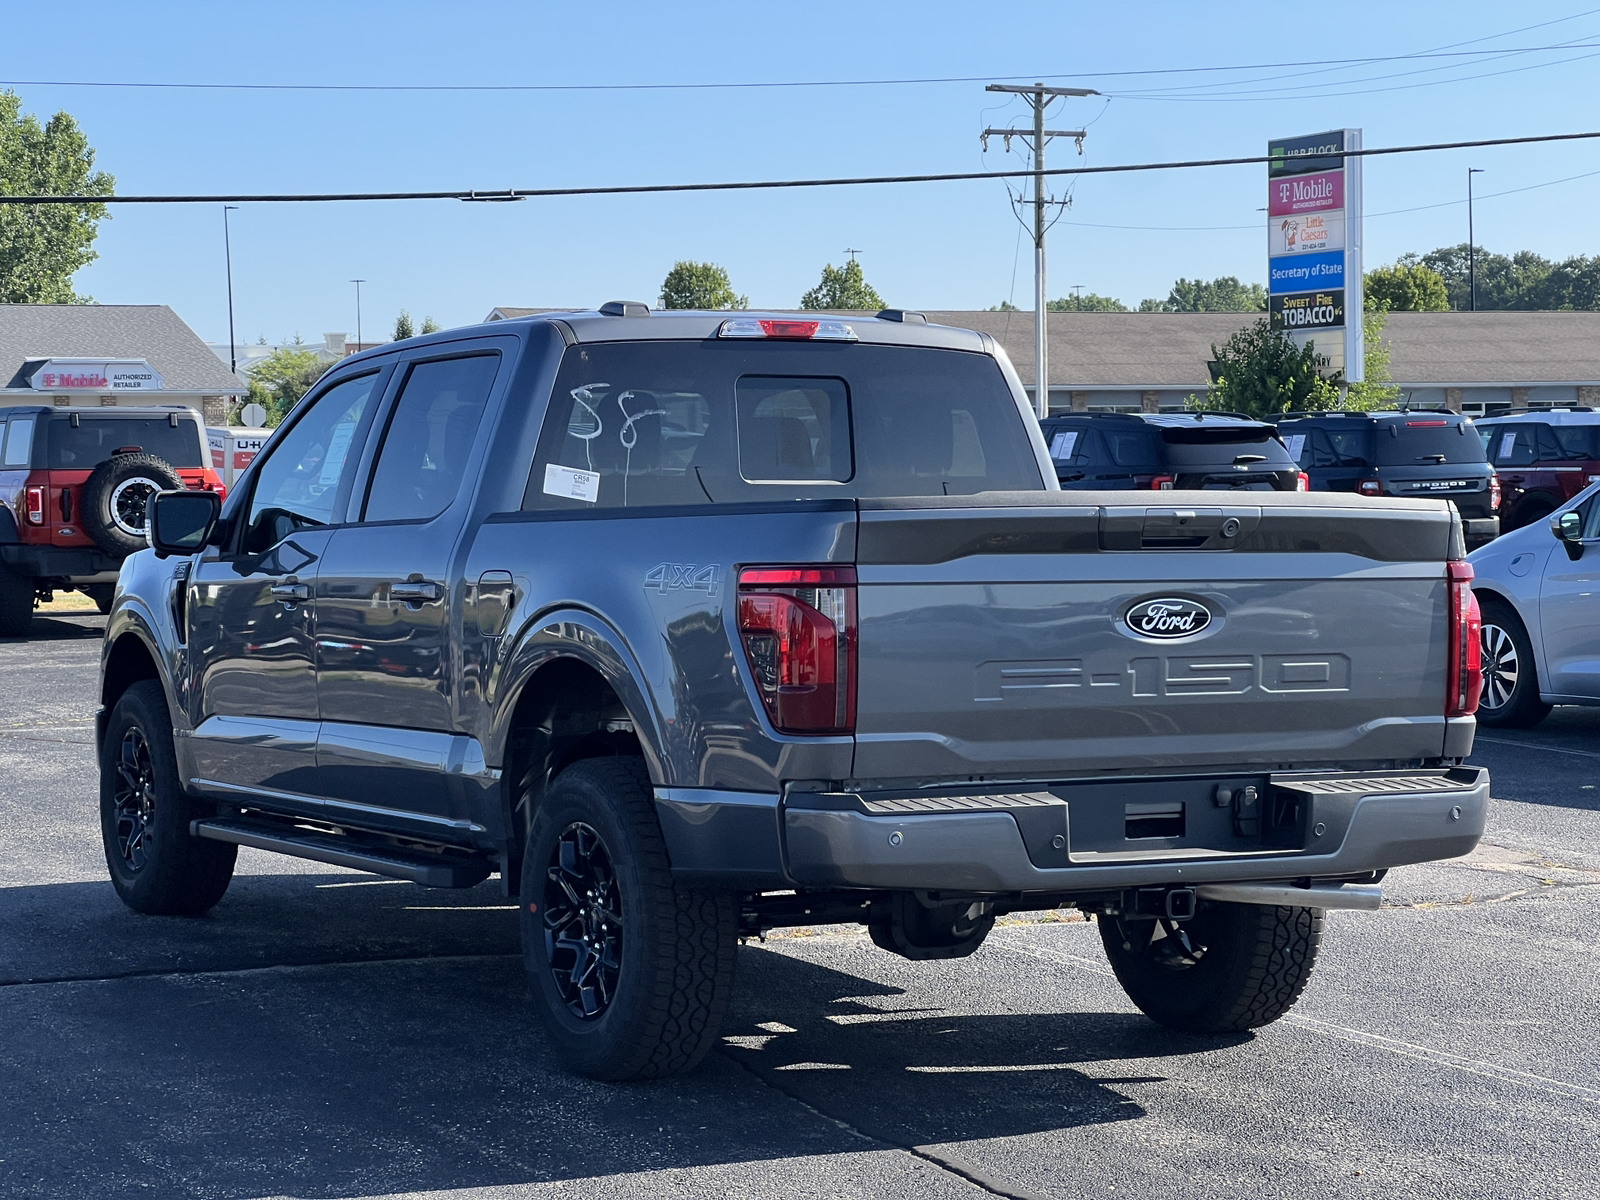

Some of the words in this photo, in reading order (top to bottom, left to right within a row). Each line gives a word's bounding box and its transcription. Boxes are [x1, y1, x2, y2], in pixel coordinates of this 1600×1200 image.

[1292, 179, 1333, 201] Mobile
[1306, 216, 1323, 228] Little
[1300, 228, 1328, 242] Caesars
[1272, 266, 1310, 280] Secretary
[1311, 265, 1320, 276] of
[1321, 263, 1342, 275] State
[1282, 306, 1334, 326] TOBACCO
[60, 374, 108, 388] Mobile
[1141, 604, 1196, 630] Ford
[974, 652, 1352, 702] F-150
